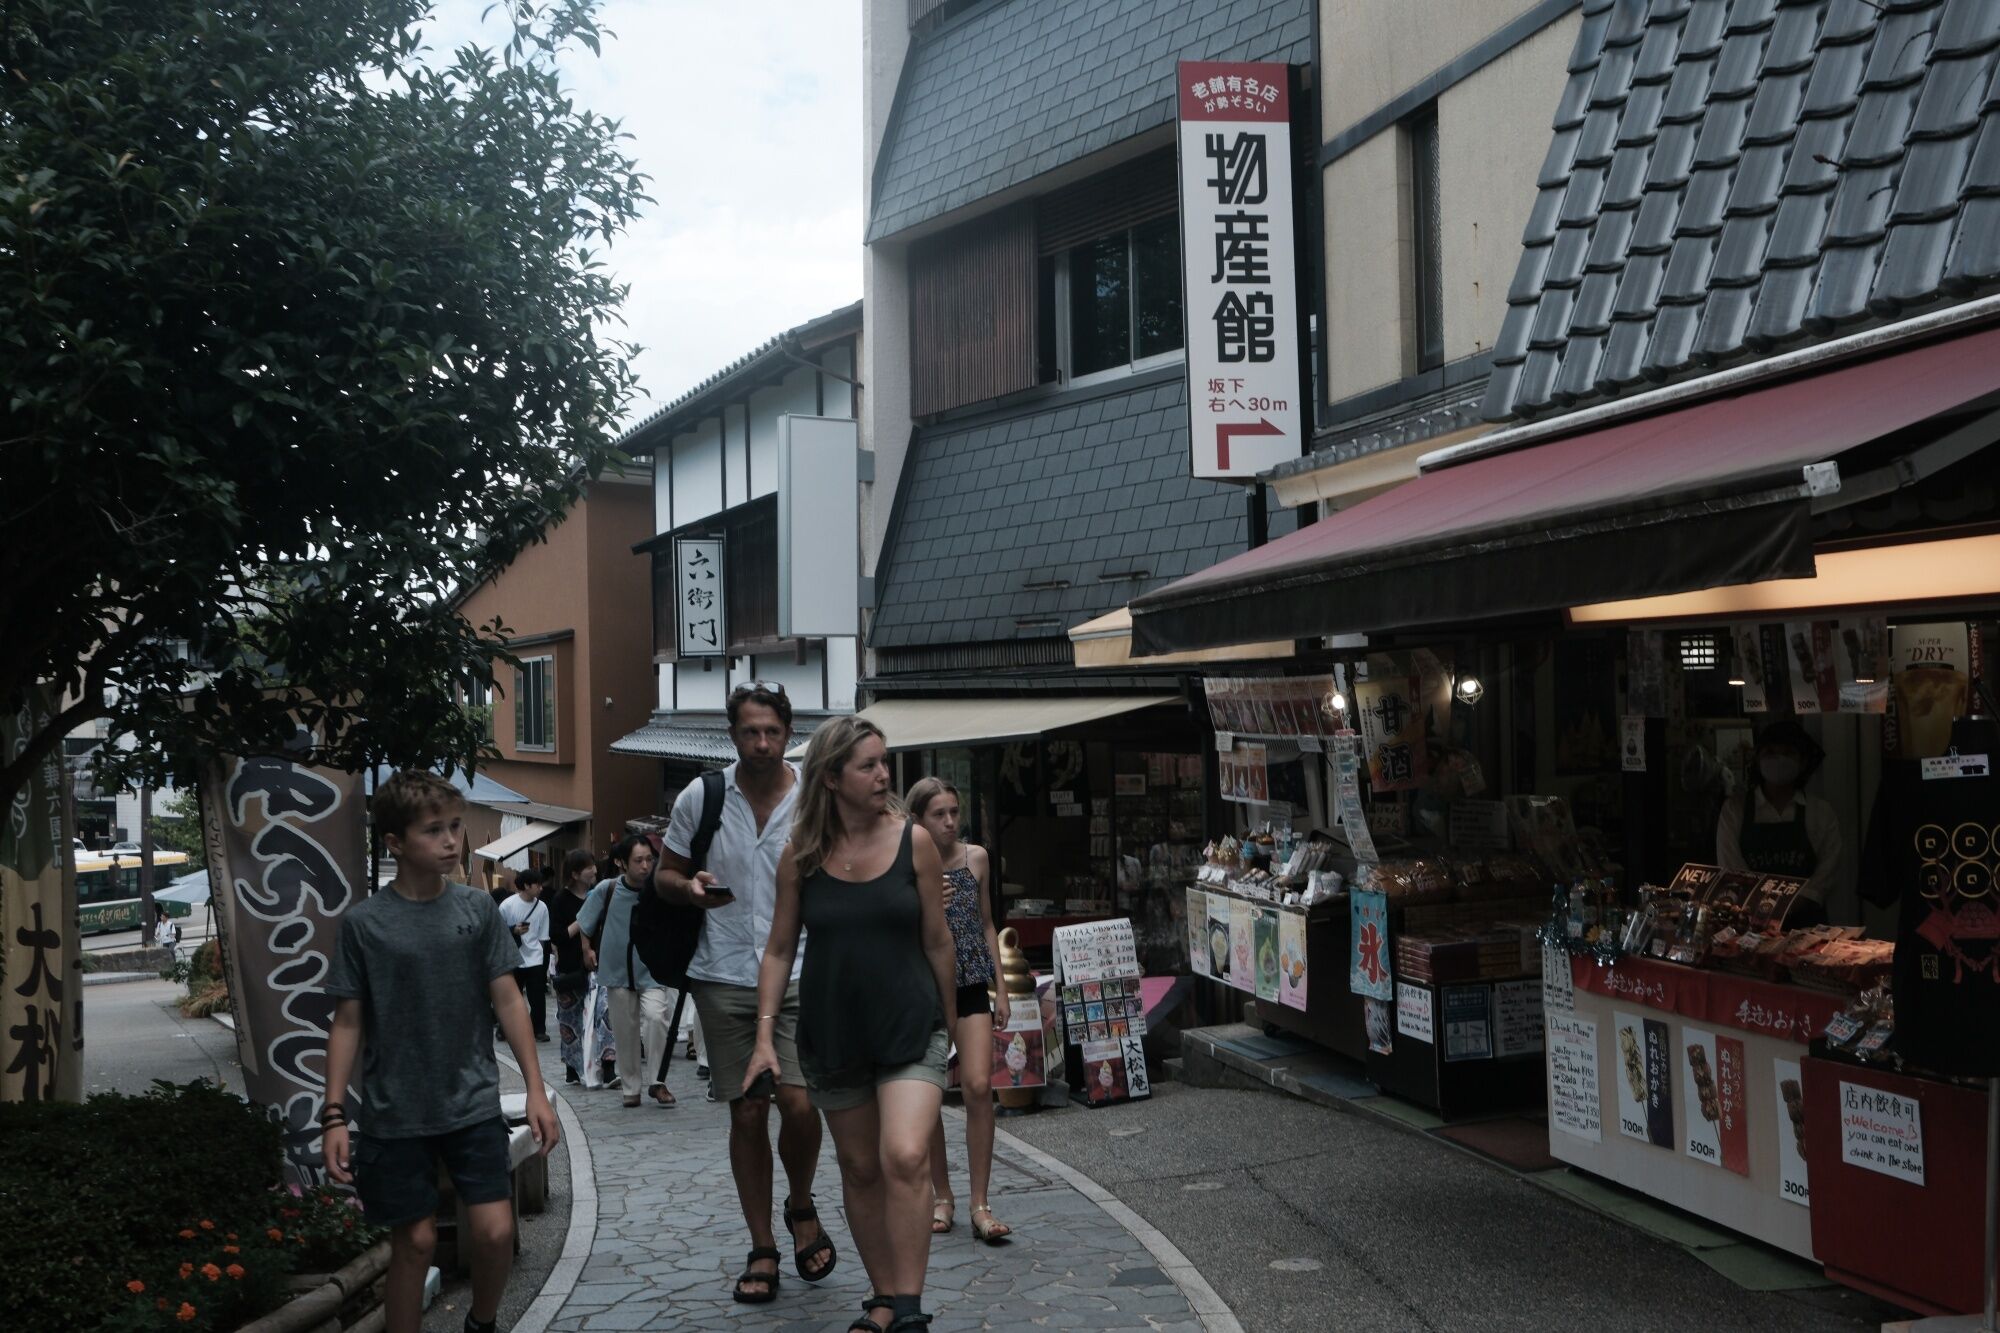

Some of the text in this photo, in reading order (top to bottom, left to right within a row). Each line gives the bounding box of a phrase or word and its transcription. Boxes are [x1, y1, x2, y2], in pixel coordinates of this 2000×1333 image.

[1191, 75, 1280, 103] 老舗有名店
[1204, 95, 1267, 114] が勢ぞろい
[1206, 131, 1276, 364] 物産館
[1208, 378, 1245, 394] 坂下
[1208, 397, 1289, 413] 右へ30m
[1918, 638, 1942, 646] SUPER
[1374, 693, 1413, 783] 甘酒
[1680, 868, 1717, 883] NEW
[1359, 922, 1389, 985] 氷
[1736, 999, 1812, 1037] 手造りおかき
[1126, 1039, 1148, 1092] 大松庵
[1648, 1031, 1660, 1108] ぬれおかき
[1720, 1047, 1733, 1130] ぬれおかき
[1844, 1086, 1914, 1122] 店内飲食可
[1622, 1118, 1644, 1136] 700円
[1851, 1114, 1905, 1137] Welcome
[1690, 1140, 1715, 1159] 500円
[1847, 1130, 1919, 1154] you can eat and
[1849, 1147, 1873, 1160] drink
[1877, 1152, 1885, 1163] in
[1902, 1158, 1922, 1174] store
